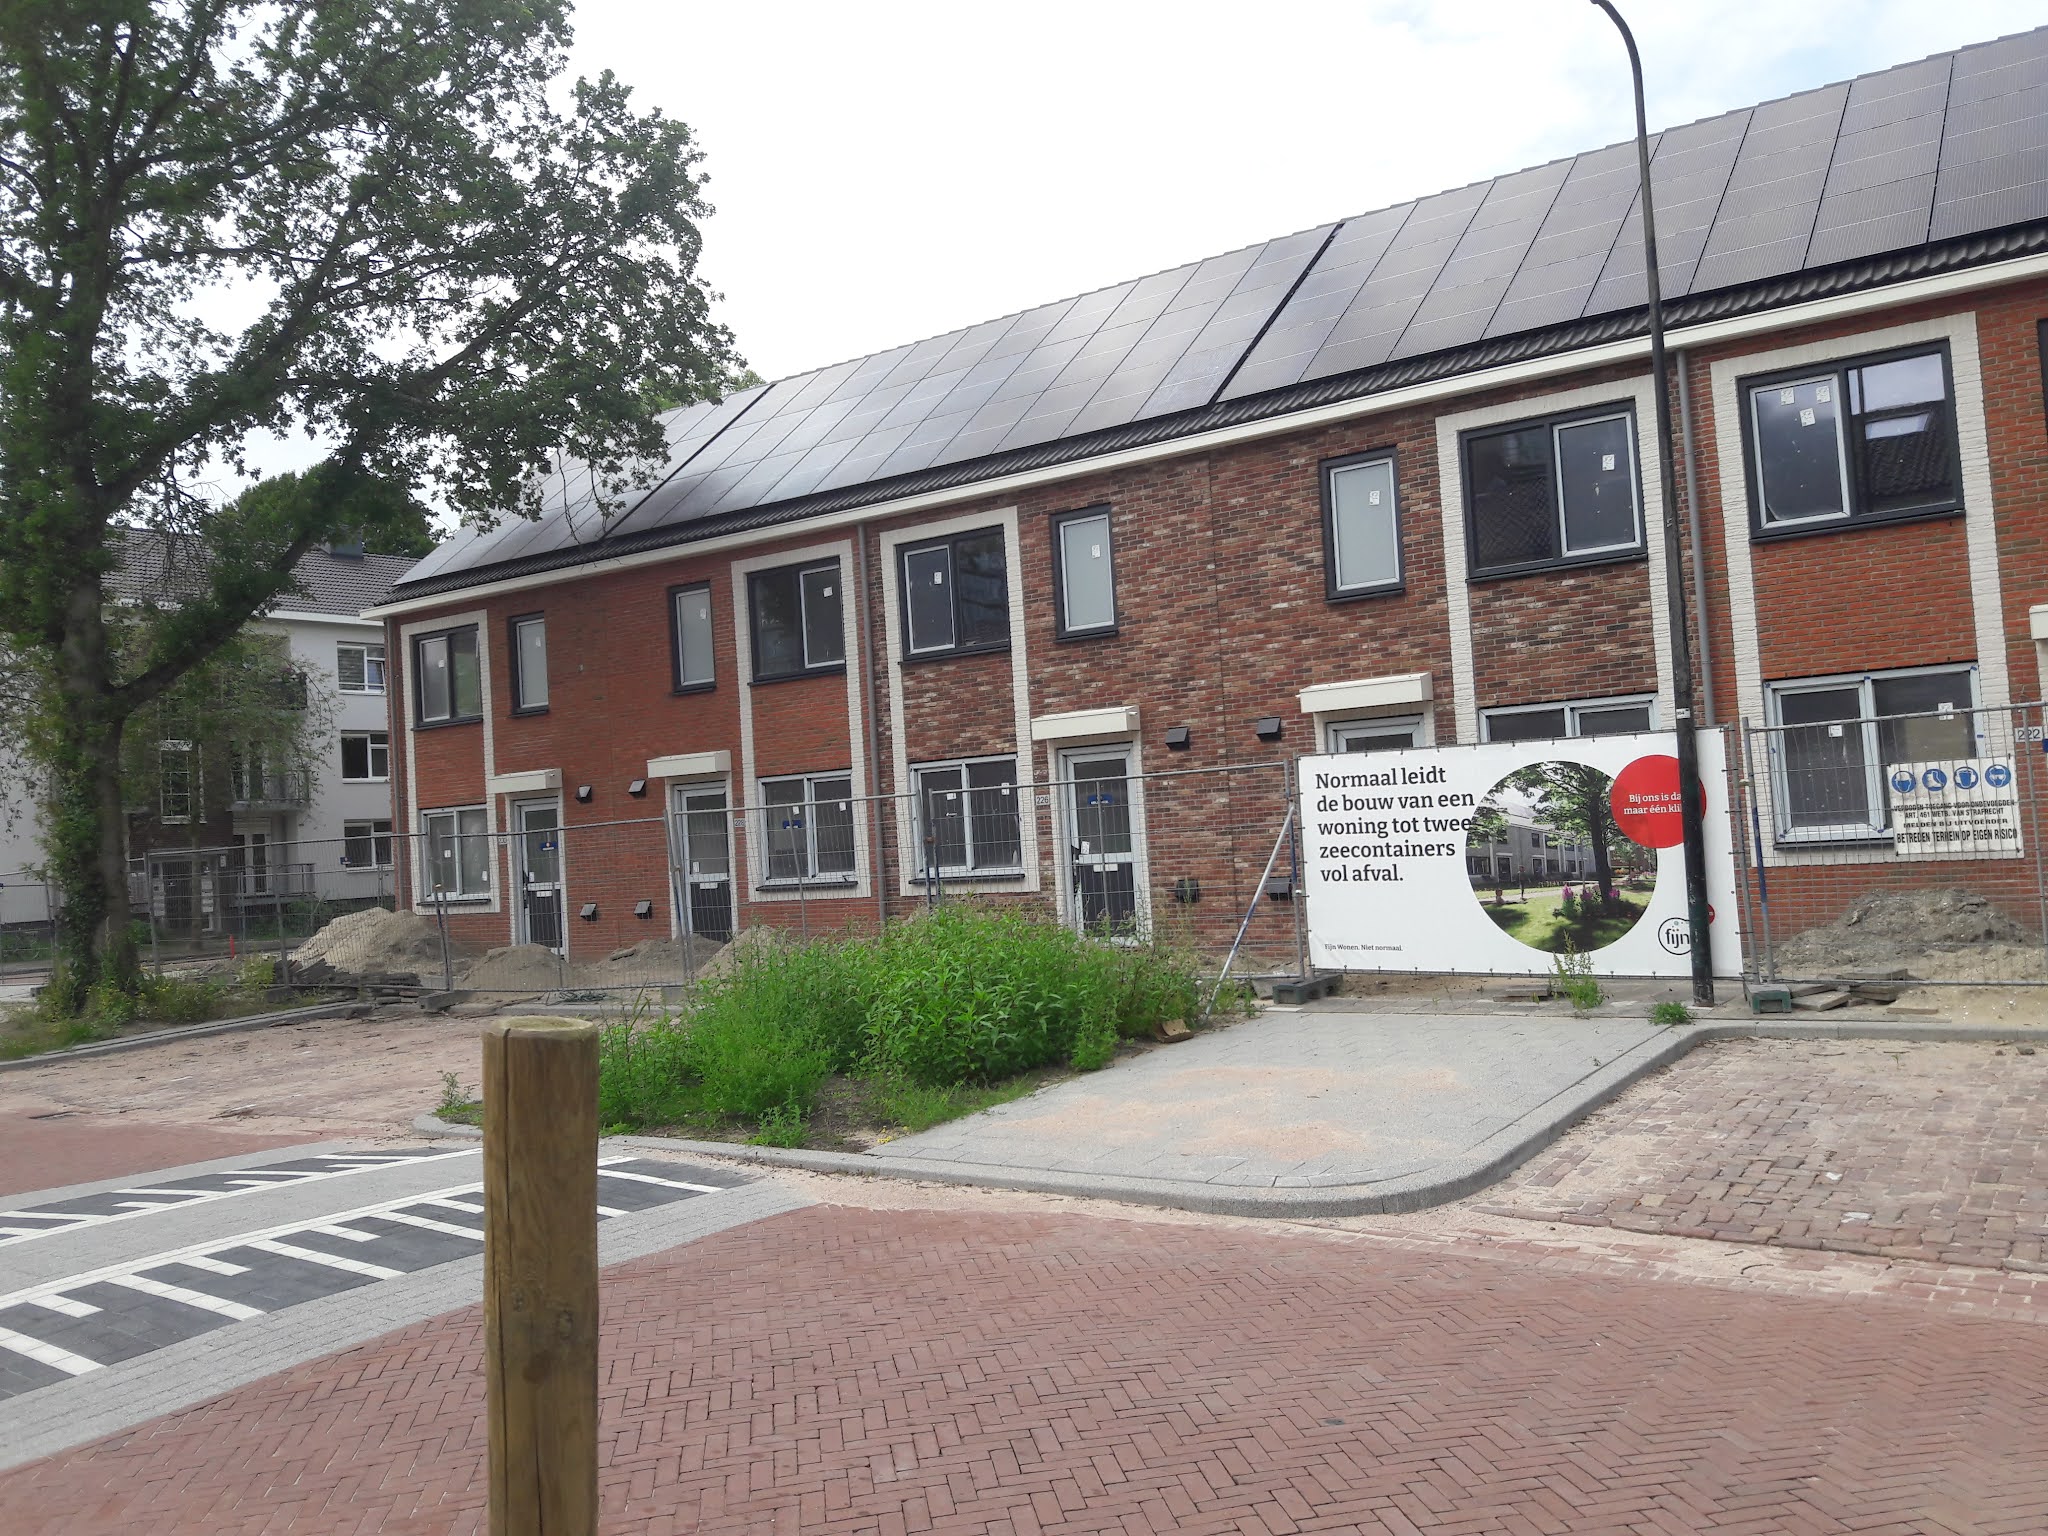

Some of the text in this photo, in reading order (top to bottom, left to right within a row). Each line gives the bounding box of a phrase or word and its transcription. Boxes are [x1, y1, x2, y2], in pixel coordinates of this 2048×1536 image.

[2017, 728, 2039, 740] 222
[1315, 765, 1447, 789] Normaal leidt
[1036, 795, 1049, 804] 226
[1316, 793, 1475, 812] de bouw van een
[1628, 792, 1681, 805] Bij ons is da
[1623, 807, 1648, 815] maar
[1649, 805, 1667, 814] één
[1904, 811, 1919, 819] ART.
[1932, 810, 1950, 818] WETB.
[1953, 809, 1965, 817] VAN
[1966, 807, 2004, 816] STRAFRECHT
[1317, 816, 1473, 839] woning tot twee
[1955, 818, 2008, 826] UITVOERDER
[1896, 828, 2018, 843] BETREDEN TERREIN OP EIGEN RISICO
[1319, 839, 1456, 859] zeecontainers
[1319, 863, 1404, 882] vol afval.
[1665, 928, 1690, 949] fijn
[1375, 944, 1404, 952] normaal.
